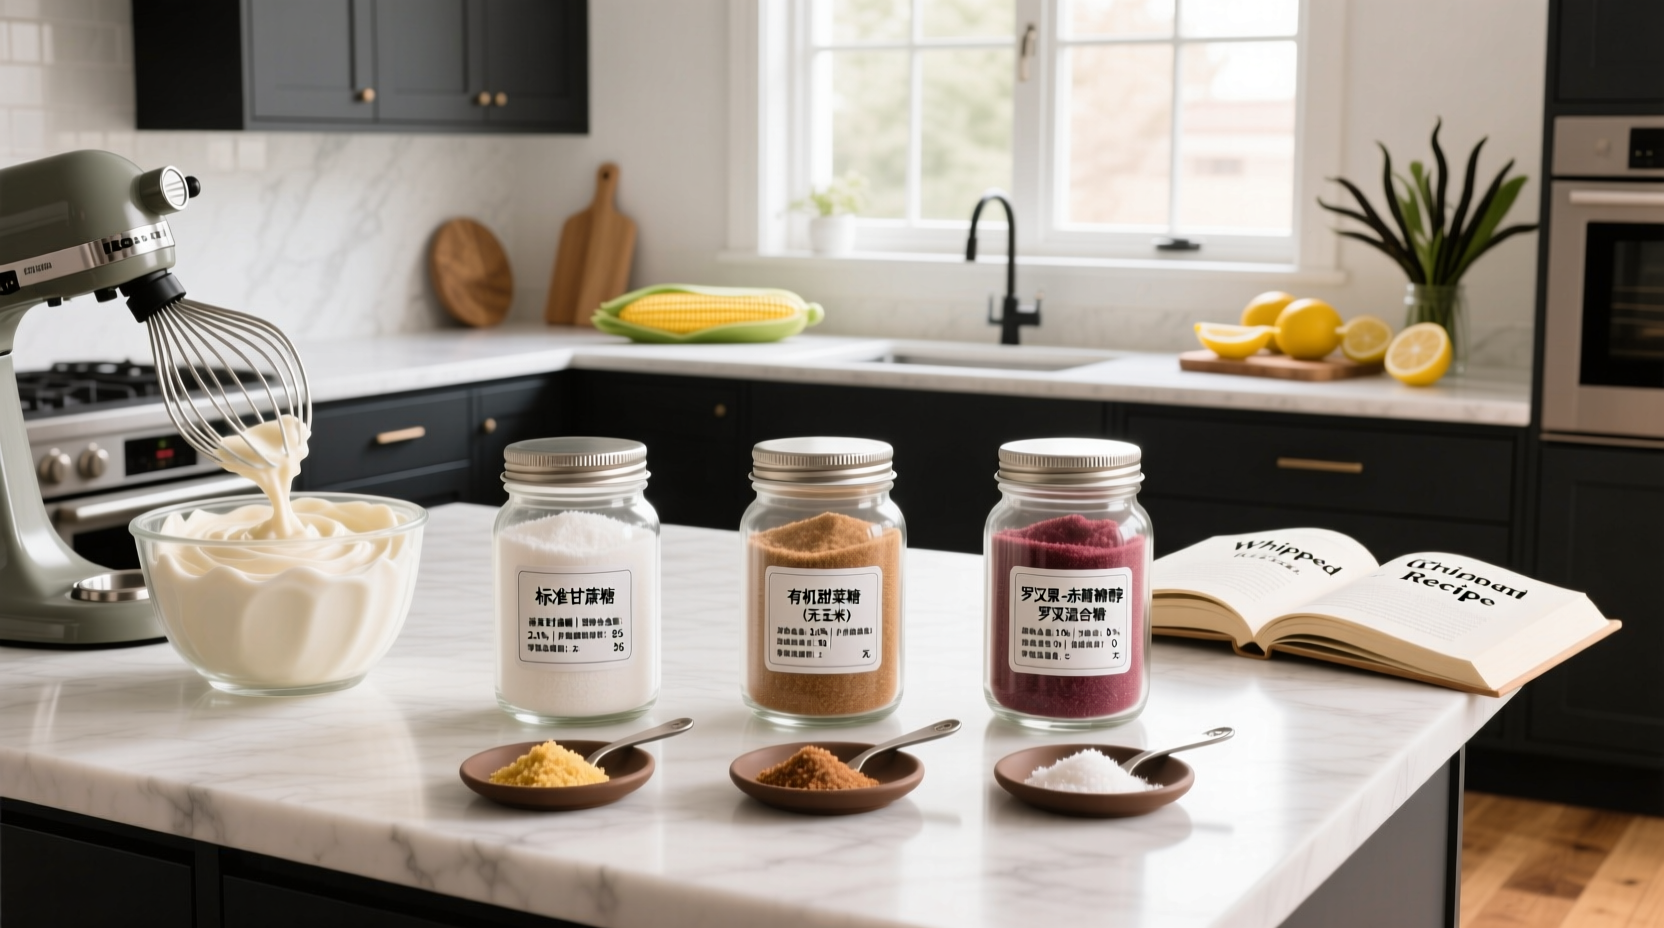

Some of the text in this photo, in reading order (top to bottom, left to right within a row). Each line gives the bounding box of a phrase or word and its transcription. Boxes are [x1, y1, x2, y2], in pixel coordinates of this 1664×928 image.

[1235, 540, 1343, 576] Whipped
[787, 588, 861, 605] 有机甜菜糖
[1399, 571, 1495, 606] Recipe
